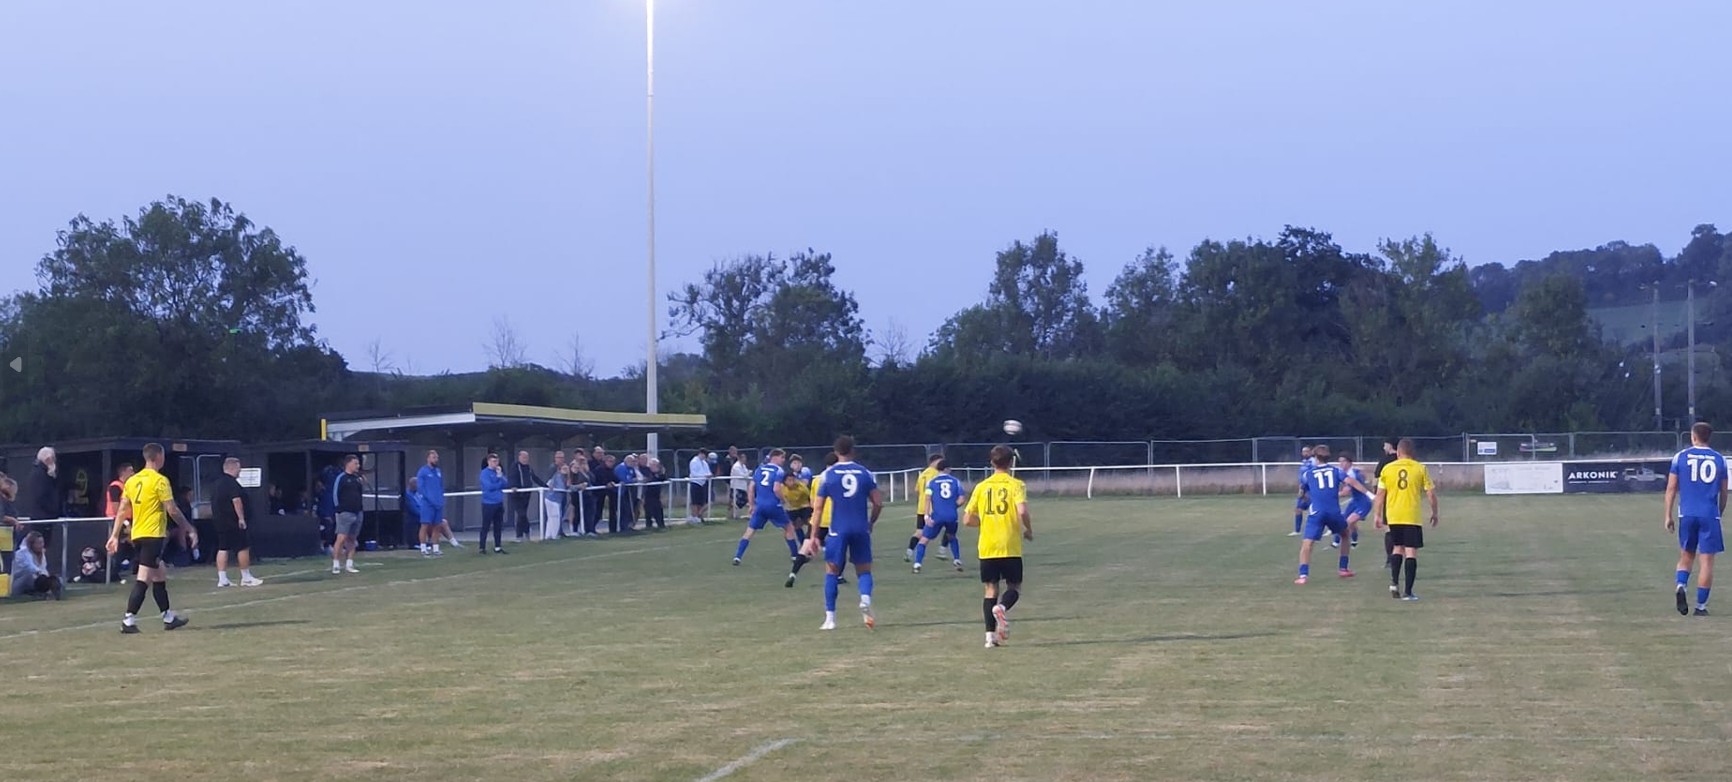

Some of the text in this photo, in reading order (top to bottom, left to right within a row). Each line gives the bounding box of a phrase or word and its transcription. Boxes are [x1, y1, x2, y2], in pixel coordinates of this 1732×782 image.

[761, 471, 770, 486] 2
[1314, 470, 1334, 489] 11
[1397, 469, 1408, 490] 8
[1568, 471, 1617, 480] ARKONIK
[1687, 459, 1716, 483] 10
[134, 481, 143, 505] 2
[841, 474, 858, 498] 9
[940, 482, 951, 499] 8
[985, 487, 1009, 515] 13
